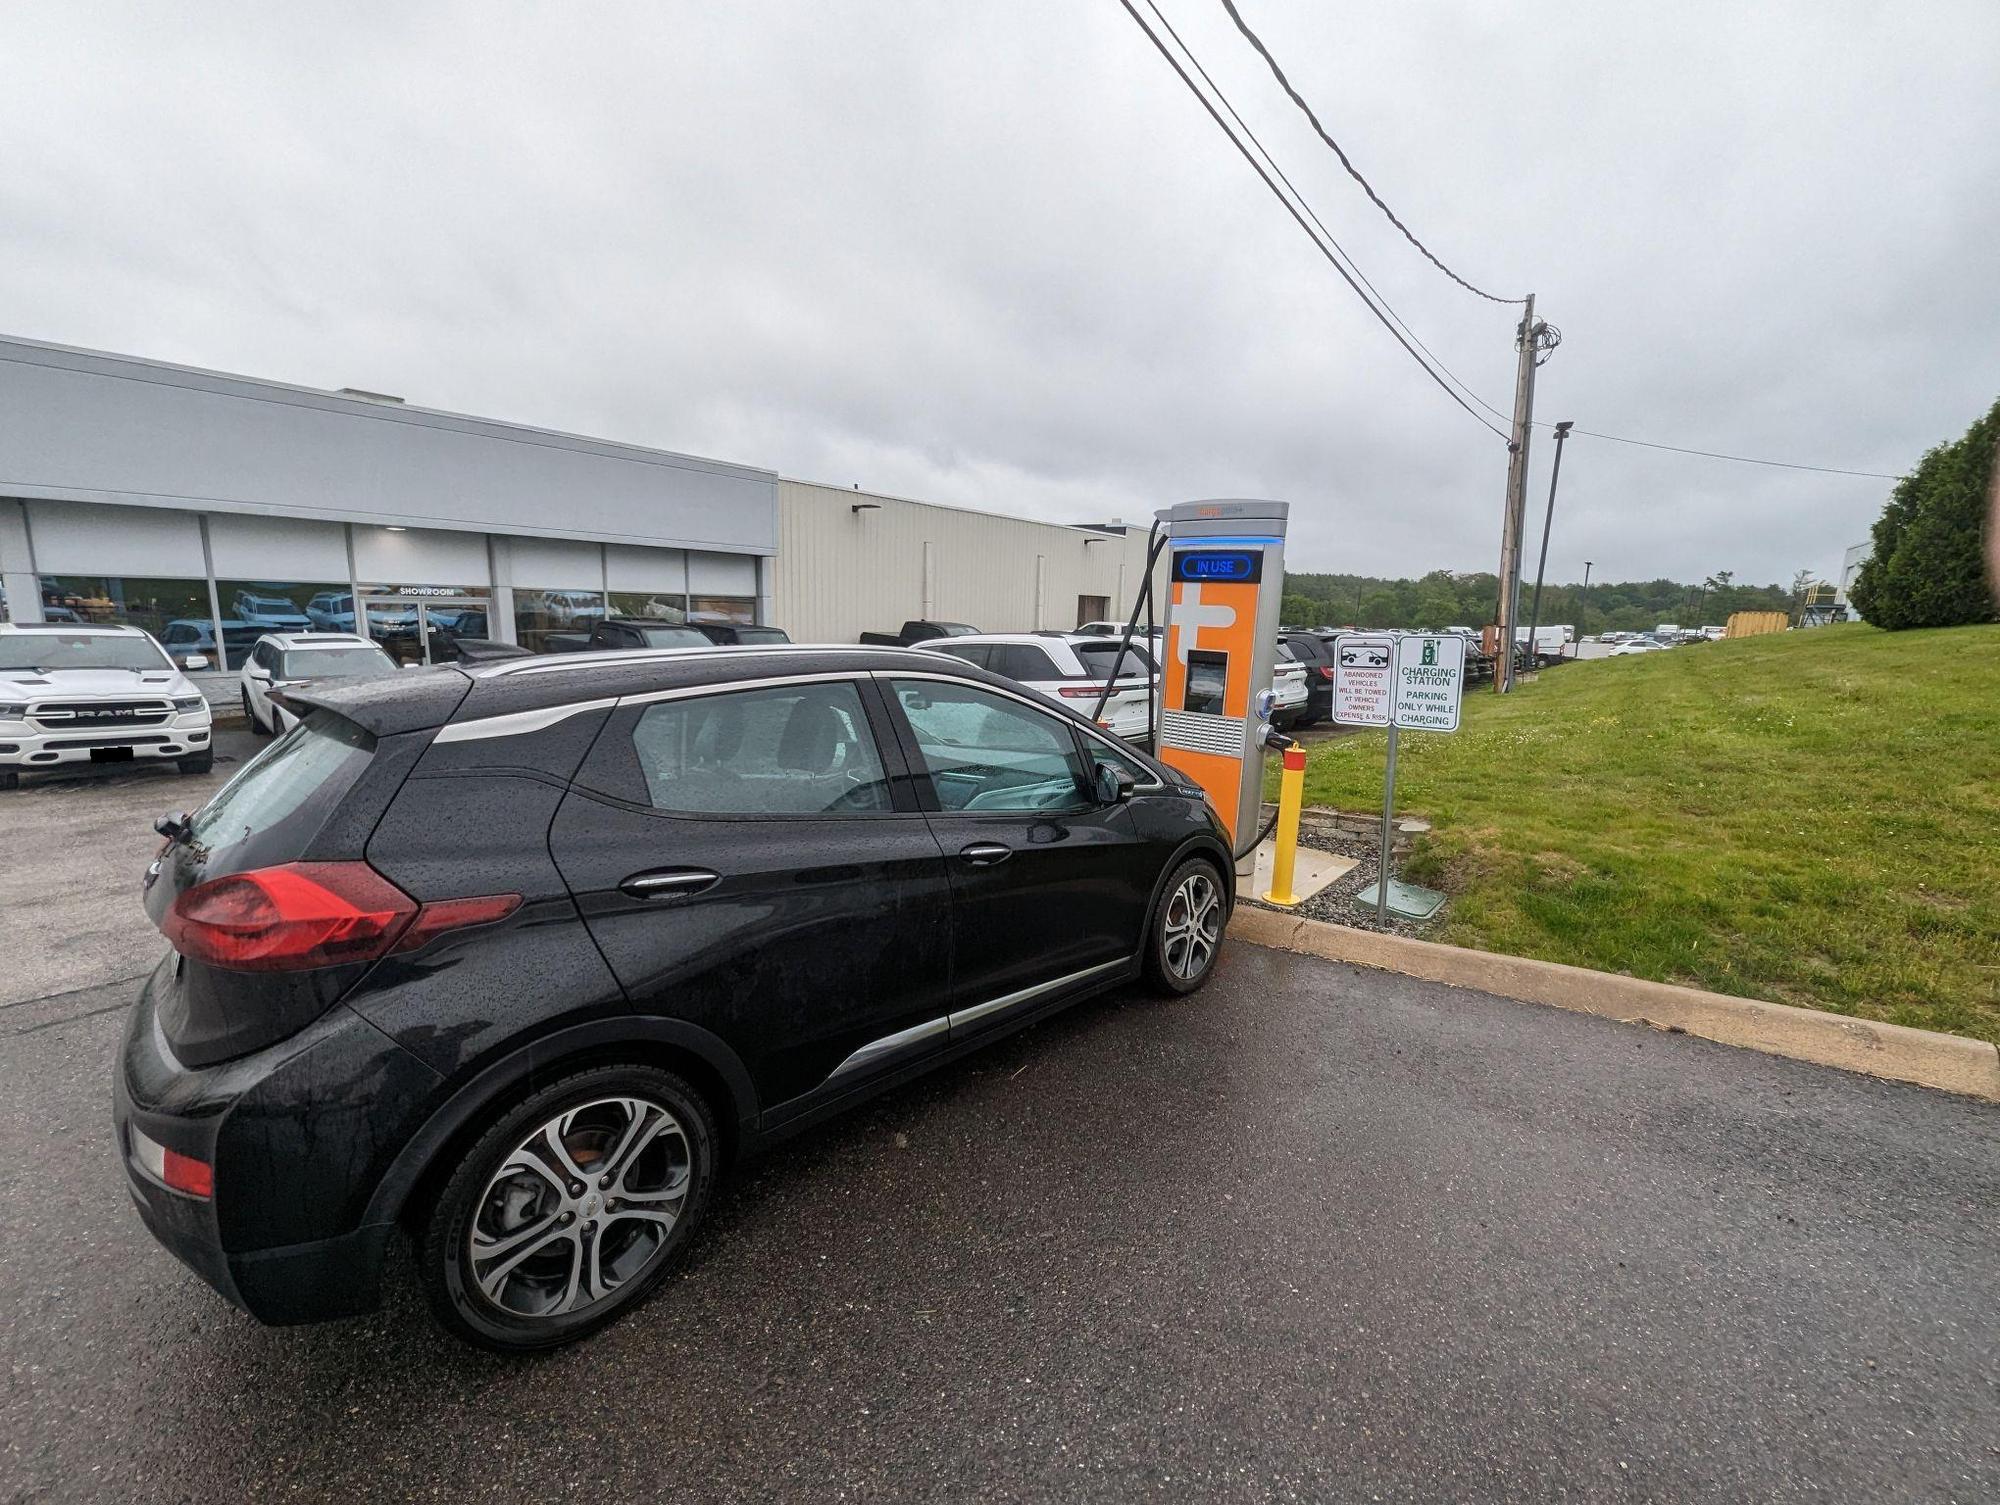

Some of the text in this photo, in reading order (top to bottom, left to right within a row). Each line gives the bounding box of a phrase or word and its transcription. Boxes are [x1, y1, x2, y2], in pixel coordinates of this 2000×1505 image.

[1197, 560, 1234, 573] IN USE
[400, 587, 454, 596] SHOWROOM
[1344, 671, 1383, 679] ABANDONED
[1402, 667, 1456, 678] CHARGING
[1406, 677, 1450, 686] STATION
[1406, 691, 1448, 701] PARKING
[1398, 702, 1454, 714] ONLY WHILE
[77, 709, 133, 717] RAM
[1336, 711, 1365, 719] EXPENSE
[1401, 714, 1449, 725] CHARGING
